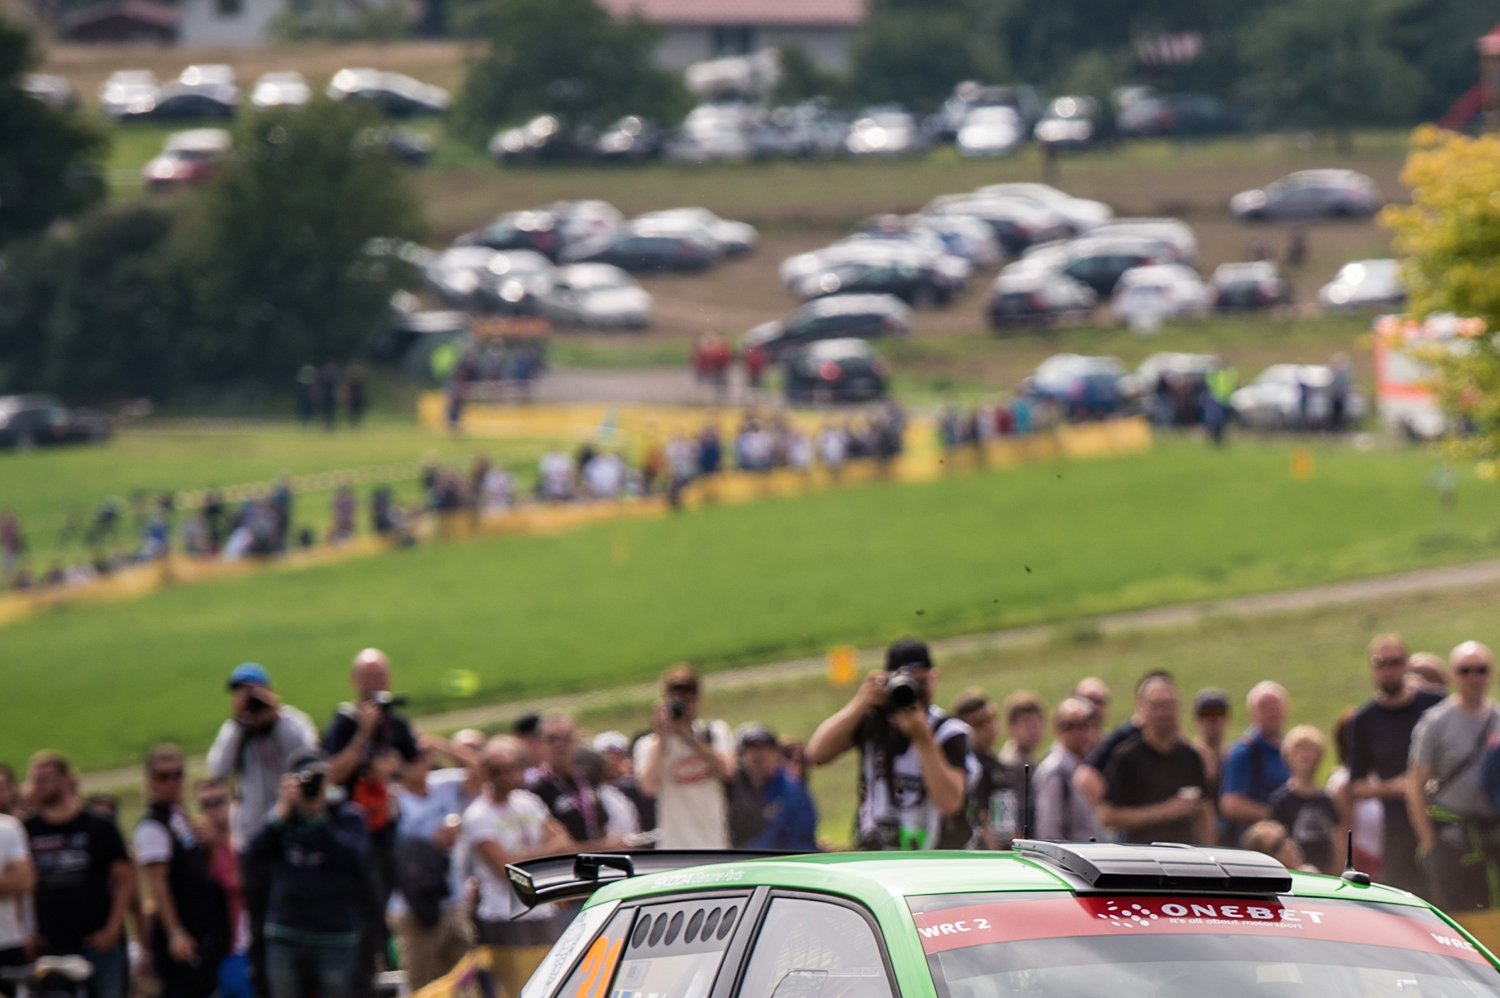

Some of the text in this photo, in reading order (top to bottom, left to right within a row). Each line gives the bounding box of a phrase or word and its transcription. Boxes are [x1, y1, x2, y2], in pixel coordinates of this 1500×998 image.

[722, 869, 745, 882] Parts
[1161, 903, 1325, 924] ONEBET
[1169, 917, 1304, 930] It's all about motorsport
[917, 918, 992, 938] WRC 2
[1430, 932, 1479, 953] WRC
